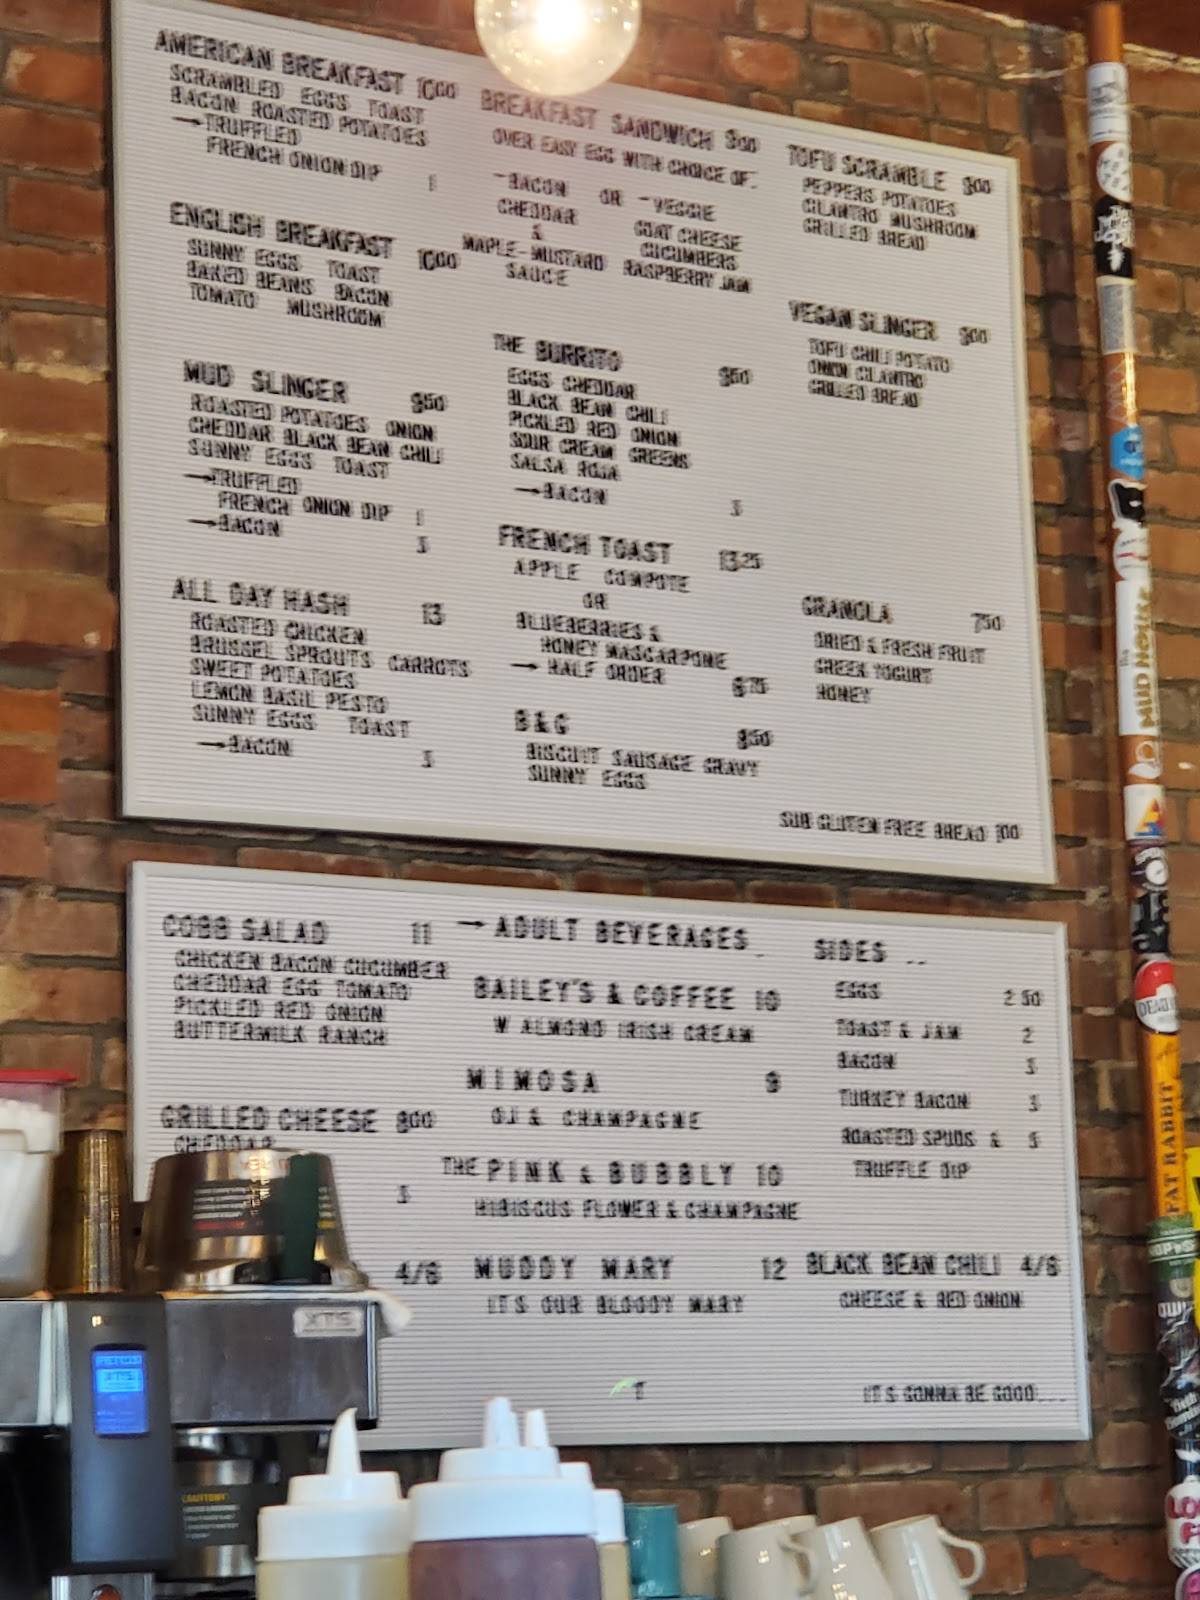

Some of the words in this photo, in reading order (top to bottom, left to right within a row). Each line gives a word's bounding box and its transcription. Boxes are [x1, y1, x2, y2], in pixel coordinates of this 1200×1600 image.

[155, 29, 273, 71] AMERICAN
[282, 52, 406, 95] BREAKFAST
[169, 64, 283, 99] SCRAMBLED
[300, 87, 350, 111] EGGS
[369, 99, 426, 124] TOAST
[170, 86, 239, 113] BACON
[251, 101, 332, 130] ROASTED
[339, 115, 428, 147] POTATOES
[481, 89, 598, 130] BREAKFAST
[611, 113, 715, 151] SANDWICH
[207, 136, 281, 165] FRENCH
[289, 150, 345, 176] ONION
[351, 161, 382, 181] DIP
[492, 127, 533, 150] OVER
[541, 135, 579, 156] EASY
[623, 151, 663, 171] WITH
[667, 159, 725, 184] CHOICE
[787, 144, 836, 172] TOFU
[842, 154, 948, 191] SCRAMBLE
[802, 198, 878, 224] CILANTRO
[890, 212, 979, 240] MUSHROOM
[882, 190, 959, 217] POTATOES
[169, 201, 265, 239] ENGLISH
[276, 219, 395, 258] BREAKFAST
[187, 238, 245, 263] SUNNY
[255, 248, 301, 271] EGGS
[327, 259, 381, 284] TOAST
[186, 260, 247, 285] BAKED
[256, 271, 315, 295] BEANS
[335, 283, 393, 307] BACON
[189, 282, 257, 309] TOMATO
[287, 298, 386, 328] MUSHROOM
[788, 300, 853, 329] VEGAN
[858, 311, 939, 341] SLINGER
[492, 332, 526, 354] THE
[535, 339, 623, 372] BURRITO
[183, 359, 234, 388] MUD
[252, 369, 349, 404] SLINGER
[507, 367, 552, 388] EGGS
[562, 375, 638, 401] CHEDDAR
[191, 393, 273, 421] ROASTED
[281, 405, 369, 434] POTATOES
[386, 419, 438, 442] ONION
[507, 388, 560, 411] BLACK
[570, 396, 614, 418] BEAN
[189, 416, 274, 444] CHEDDAR
[284, 428, 338, 451] BLACK
[346, 436, 393, 458] BEAN
[508, 410, 578, 435] PICKLED
[587, 420, 620, 440] RED
[631, 427, 682, 447] ONION
[187, 438, 252, 462] SUNNY
[264, 447, 314, 470] EGGS
[334, 456, 390, 479] TOAST
[218, 491, 292, 516] FRENCH
[303, 495, 353, 518] ONION
[360, 501, 392, 522] DIP
[543, 482, 608, 505] BACON
[218, 514, 283, 537] BACON
[498, 524, 591, 555] FRENCH
[599, 535, 674, 565] TOAST
[513, 558, 581, 581] APPLE
[604, 568, 691, 593] COMPOTE
[172, 576, 217, 603] ALL
[229, 581, 275, 608] DAY
[284, 587, 351, 617] HASH
[422, 602, 446, 626] 13
[582, 592, 609, 610] OR
[802, 595, 894, 625] GRANOLA
[190, 611, 277, 637] ROASTED
[284, 620, 368, 645] CHICKEN
[190, 634, 277, 660] BRUSSEL
[285, 644, 374, 669] SPROUTS
[388, 653, 473, 678] CARROTS
[540, 636, 600, 658] HONEY
[604, 641, 730, 671] MASCARPONE
[190, 658, 253, 679] SWEET
[261, 664, 357, 689] POTATOES
[192, 703, 257, 725] SUNNY
[266, 709, 317, 731] EGGS
[348, 716, 411, 738] TOAST
[229, 734, 294, 757] BACON
[526, 742, 602, 764] BISCUIT
[612, 749, 695, 772] SAUSAGE
[703, 757, 760, 777] GRAVY
[162, 914, 232, 941] COBB
[241, 916, 329, 944] SALAD
[175, 948, 263, 971] CHICKEN
[271, 952, 334, 975] BACON
[344, 956, 449, 980] CUCUMBER
[174, 973, 270, 995] CHEDDAR
[282, 976, 322, 997] EGG
[337, 978, 413, 1000] TOMATO
[473, 975, 595, 1005] BAILEY'S
[607, 982, 622, 1005] &
[633, 985, 735, 1010] COFFEE
[755, 989, 781, 1012] 10
[835, 980, 881, 1000] EGGS
[174, 995, 263, 1017] PICKLED
[274, 1000, 315, 1020] RED
[325, 1003, 386, 1023] ONION
[174, 1020, 306, 1043] BUTTERMILK
[319, 1024, 388, 1045] RANCH
[521, 1018, 606, 1039] ALMOND
[618, 1021, 674, 1041] IRISH
[684, 1023, 755, 1043] CREAM
[837, 1018, 893, 1038] TOAST
[921, 1023, 962, 1040] JAM
[1022, 1027, 1034, 1043] 2
[839, 1088, 906, 1108] TURKEY
[914, 1091, 971, 1109] BACON
[160, 1104, 270, 1131] GRILLED
[278, 1106, 379, 1133] CHEESE
[1160, 1082, 1178, 1165] RABBIT
[442, 1156, 479, 1176] THE
[487, 1158, 564, 1183] PINK
[609, 1160, 734, 1186] BUBBLY
[756, 1163, 783, 1186] 10
[474, 1255, 576, 1279] MUDDY
[601, 1256, 673, 1279] MARY
[761, 1257, 787, 1280] 12
[806, 1251, 873, 1275] BLACK
[882, 1252, 938, 1275] BEAN
[946, 1253, 1001, 1276] CHILI
[541, 1295, 582, 1314] OUR
[596, 1295, 674, 1314] BLOODY
[689, 1295, 745, 1313] MARY
[839, 1290, 908, 1309] CHEESE
[937, 1290, 966, 1308] RED
[973, 1291, 1023, 1308] ONION
[965, 1384, 988, 1402] BE
